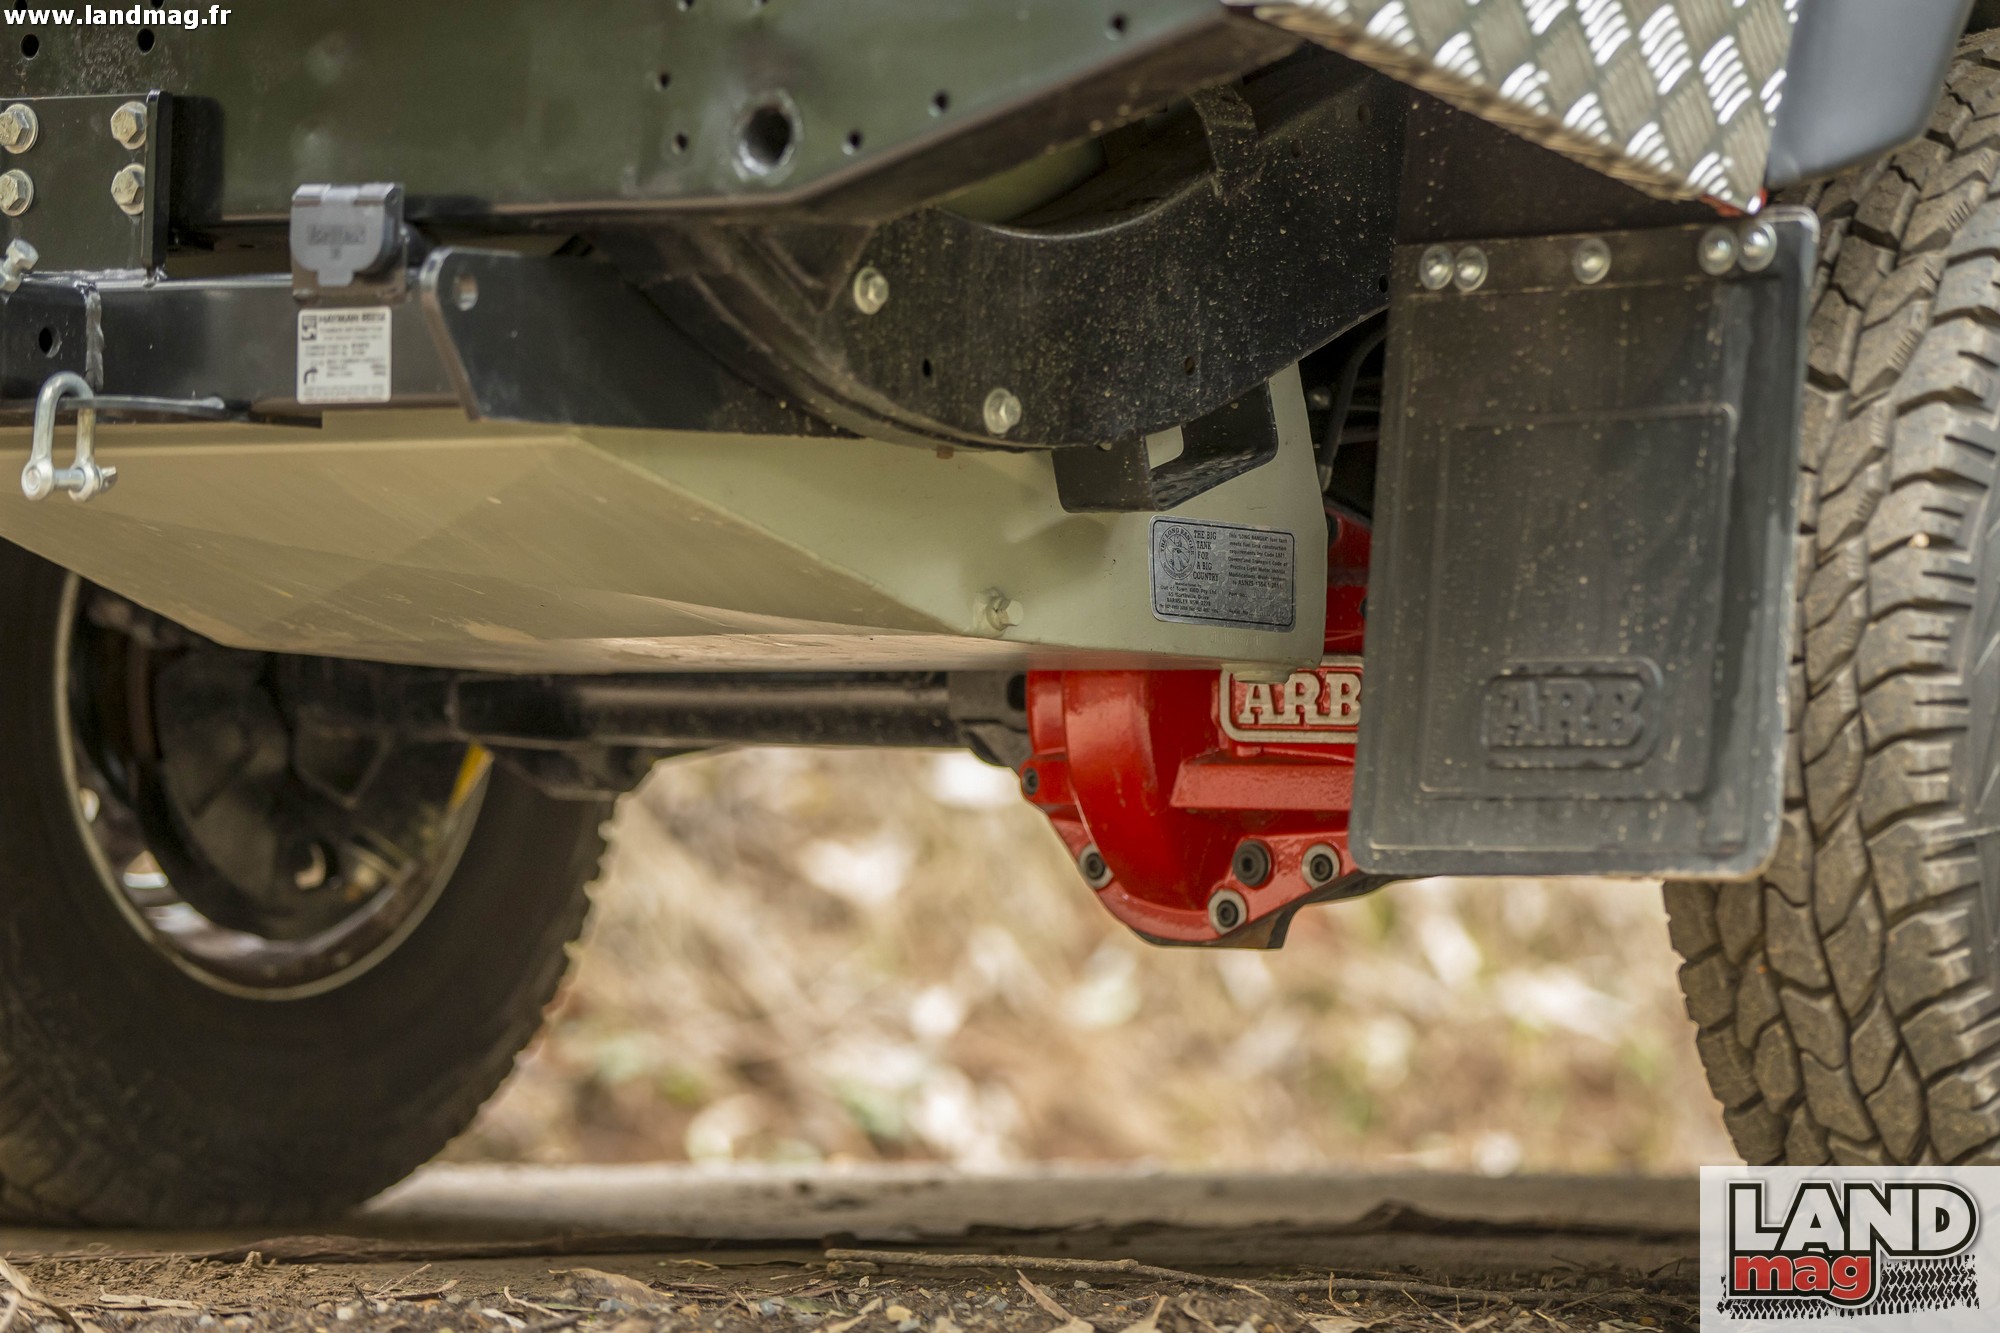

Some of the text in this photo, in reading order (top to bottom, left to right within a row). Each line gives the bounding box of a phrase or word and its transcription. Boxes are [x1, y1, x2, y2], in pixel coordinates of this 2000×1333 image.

[1166, 527, 1180, 539] LONG
[1194, 530, 1217, 540] THE BIG
[1196, 540, 1212, 550] TANK
[1197, 551, 1209, 560] FOR
[1196, 561, 1201, 570] A
[1202, 561, 1213, 571] BIG
[1193, 571, 1219, 582] COUNTRY
[1238, 672, 1362, 725] ARB
[1490, 676, 1645, 748] ARB
